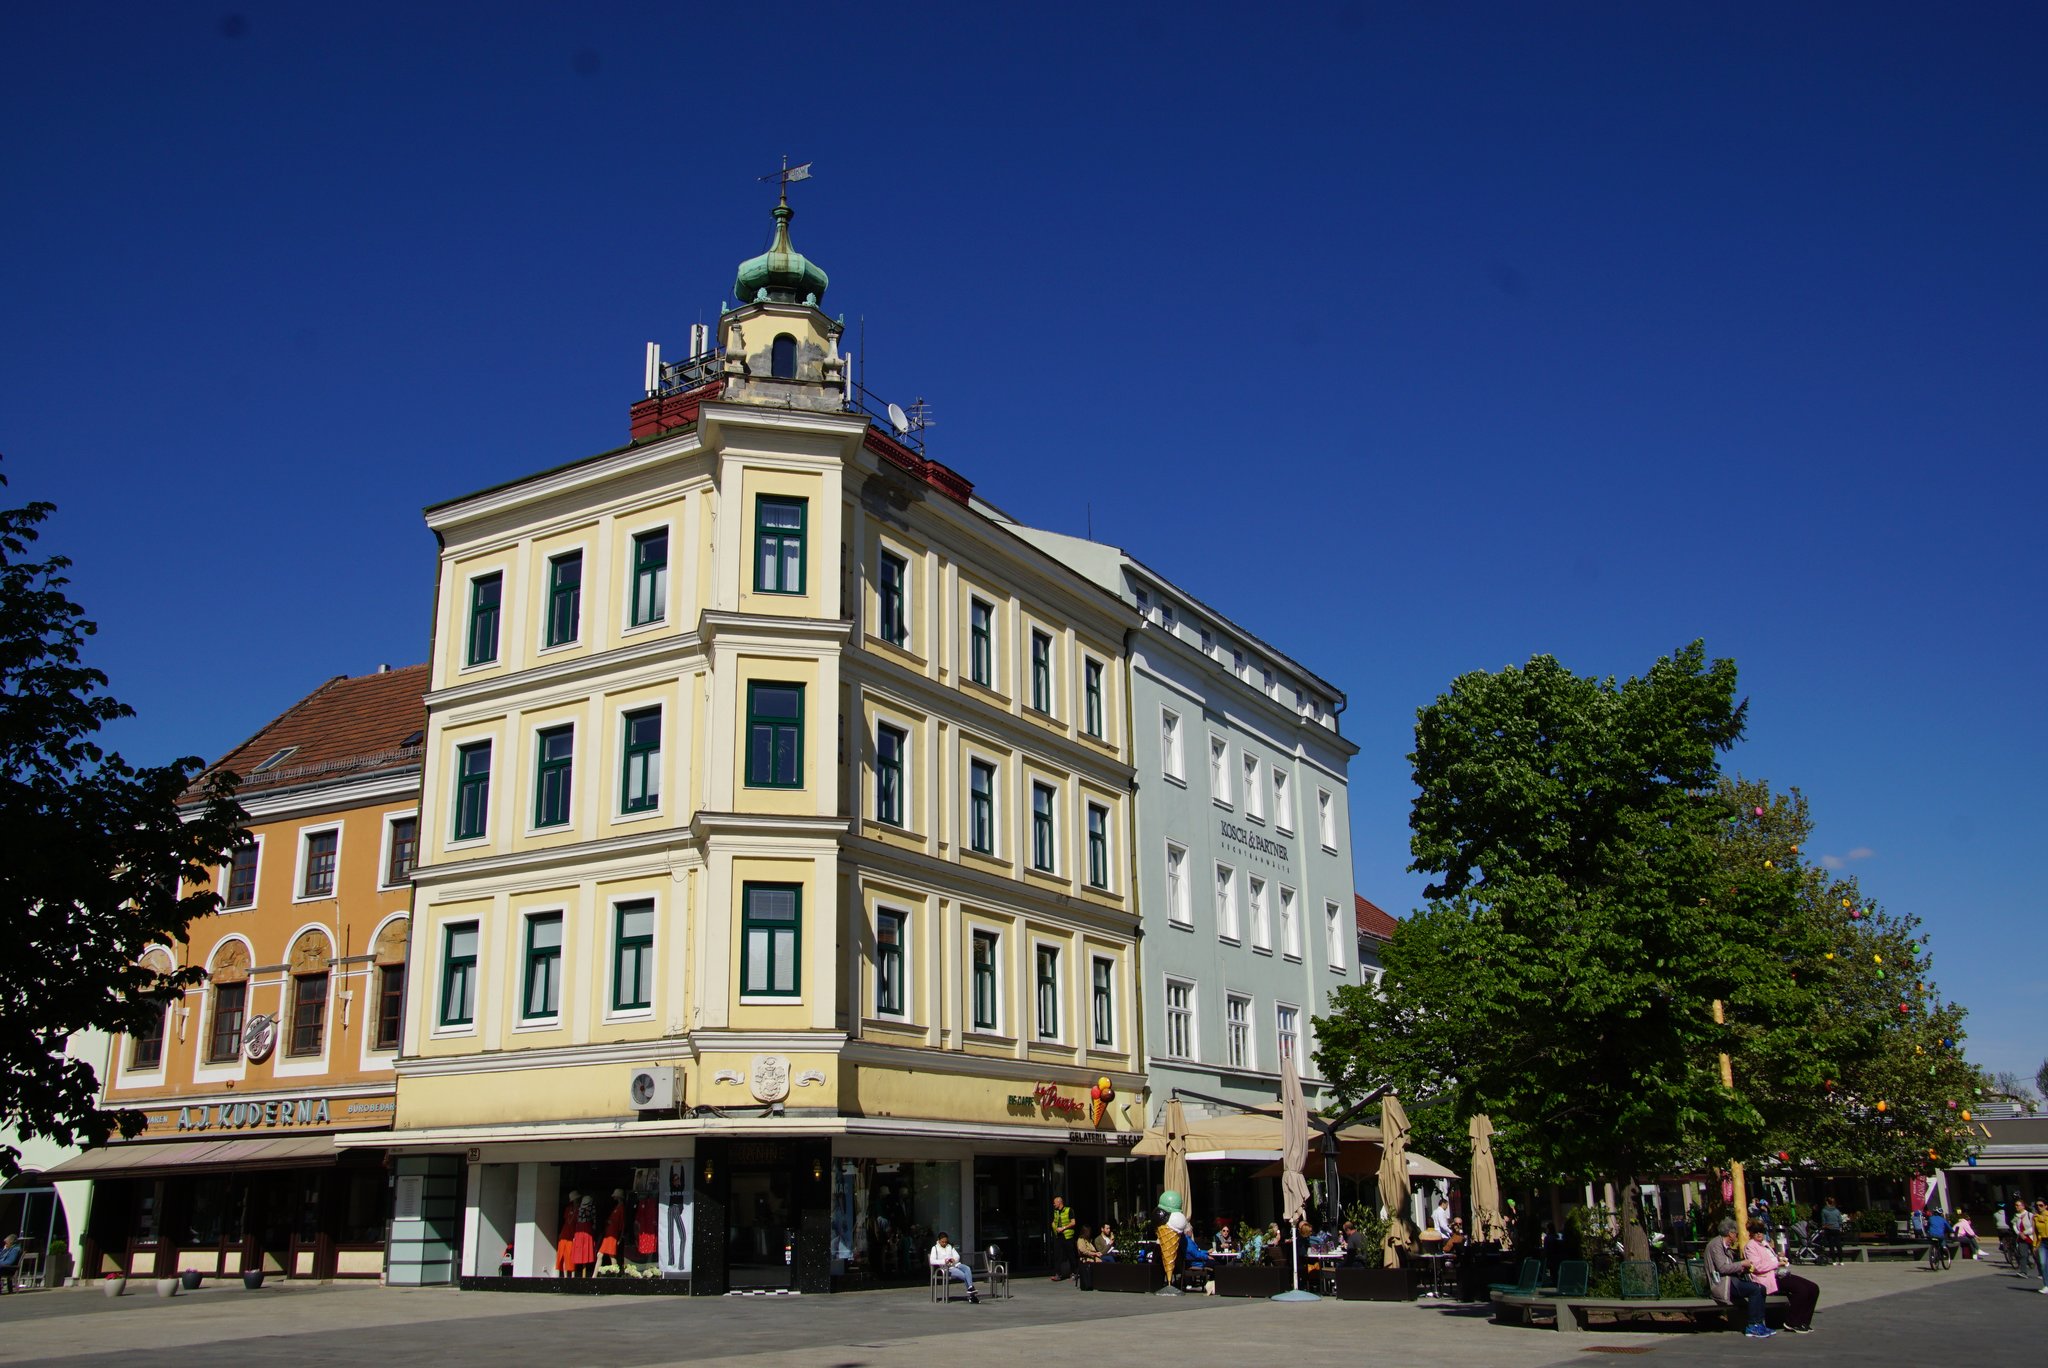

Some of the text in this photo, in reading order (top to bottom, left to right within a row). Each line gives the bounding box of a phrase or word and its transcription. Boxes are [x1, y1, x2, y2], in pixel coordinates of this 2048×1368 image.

[1221, 820, 1289, 861] KOSCH & PARTNER
[218, 1098, 331, 1127] KUDERNA
[348, 1102, 396, 1113] BÜROBEDAR
[1070, 1132, 1107, 1144] GELATERIA
